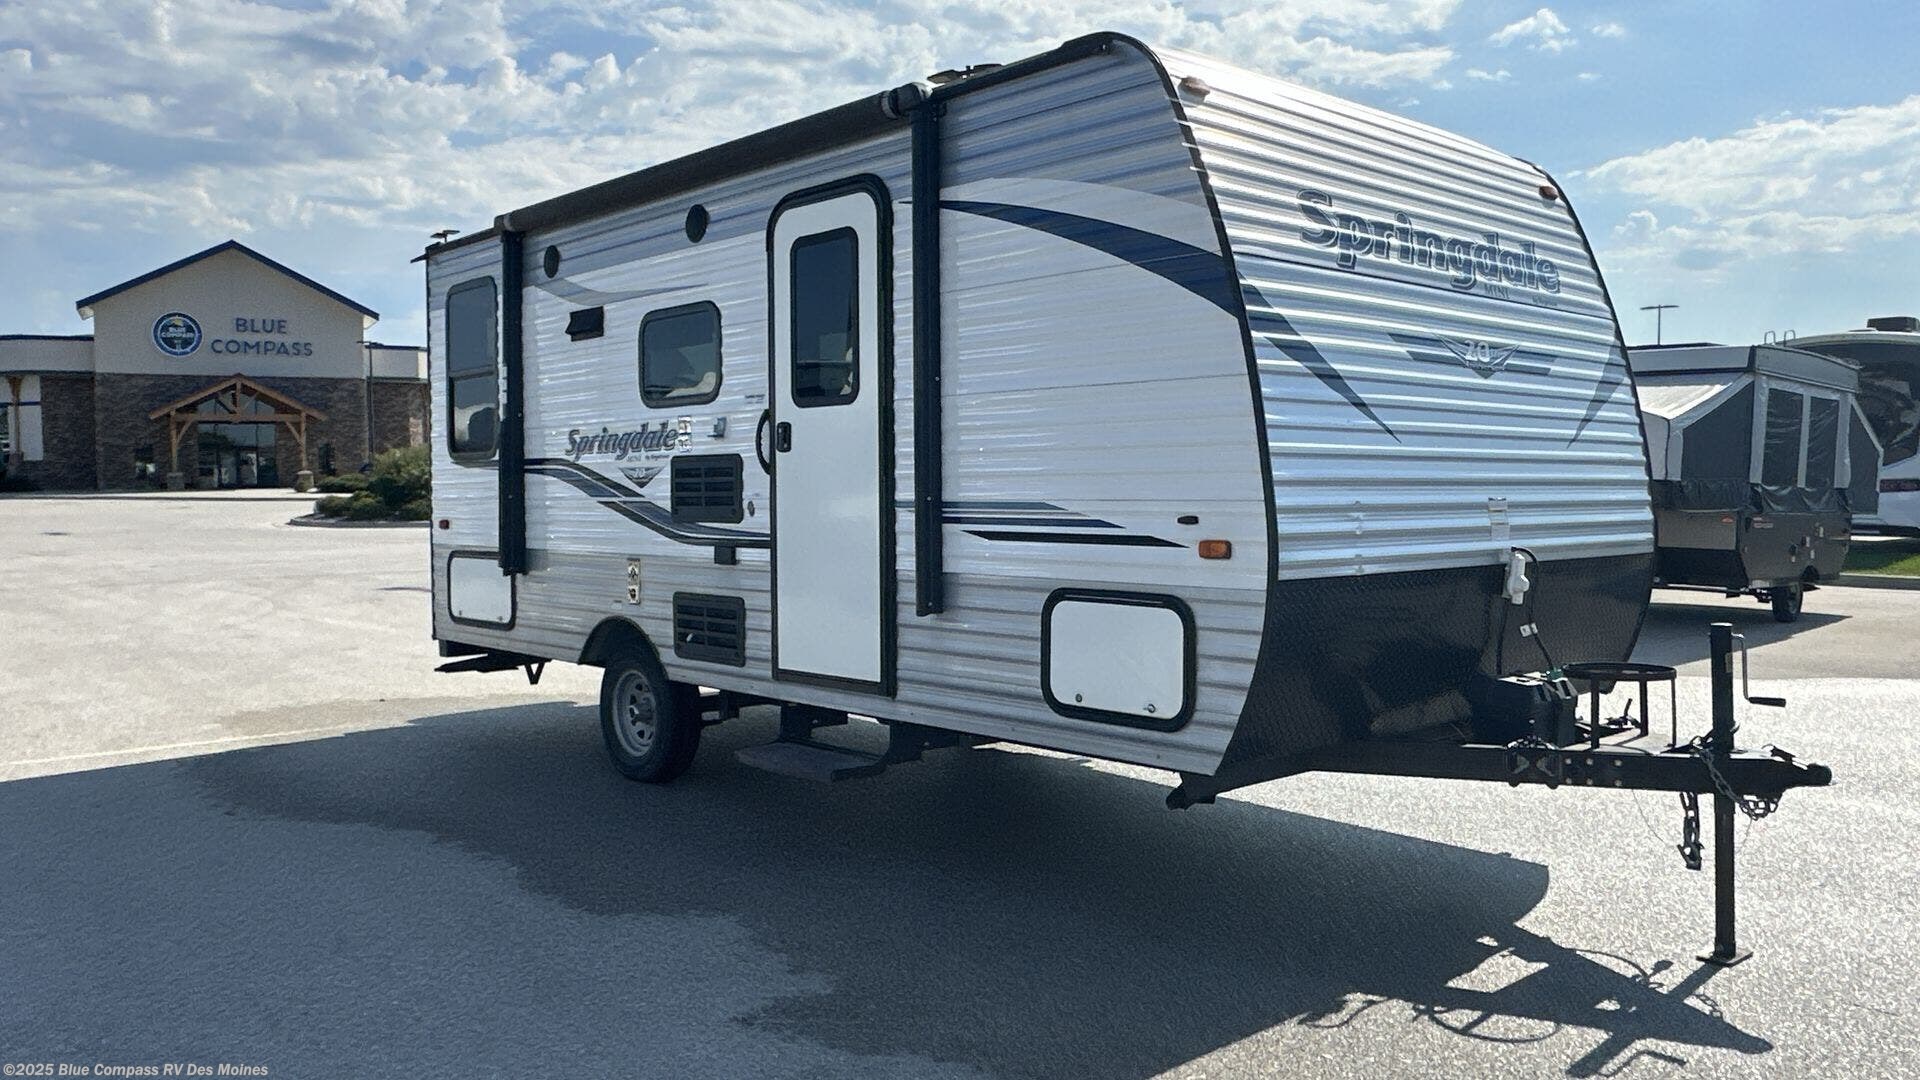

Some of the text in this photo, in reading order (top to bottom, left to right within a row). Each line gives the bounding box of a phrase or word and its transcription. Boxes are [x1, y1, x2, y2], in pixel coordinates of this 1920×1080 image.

[1297, 189, 1560, 294] Springdale
[235, 318, 287, 334] BLUE
[211, 339, 313, 356] COMPASS
[565, 420, 679, 463] Springdale
